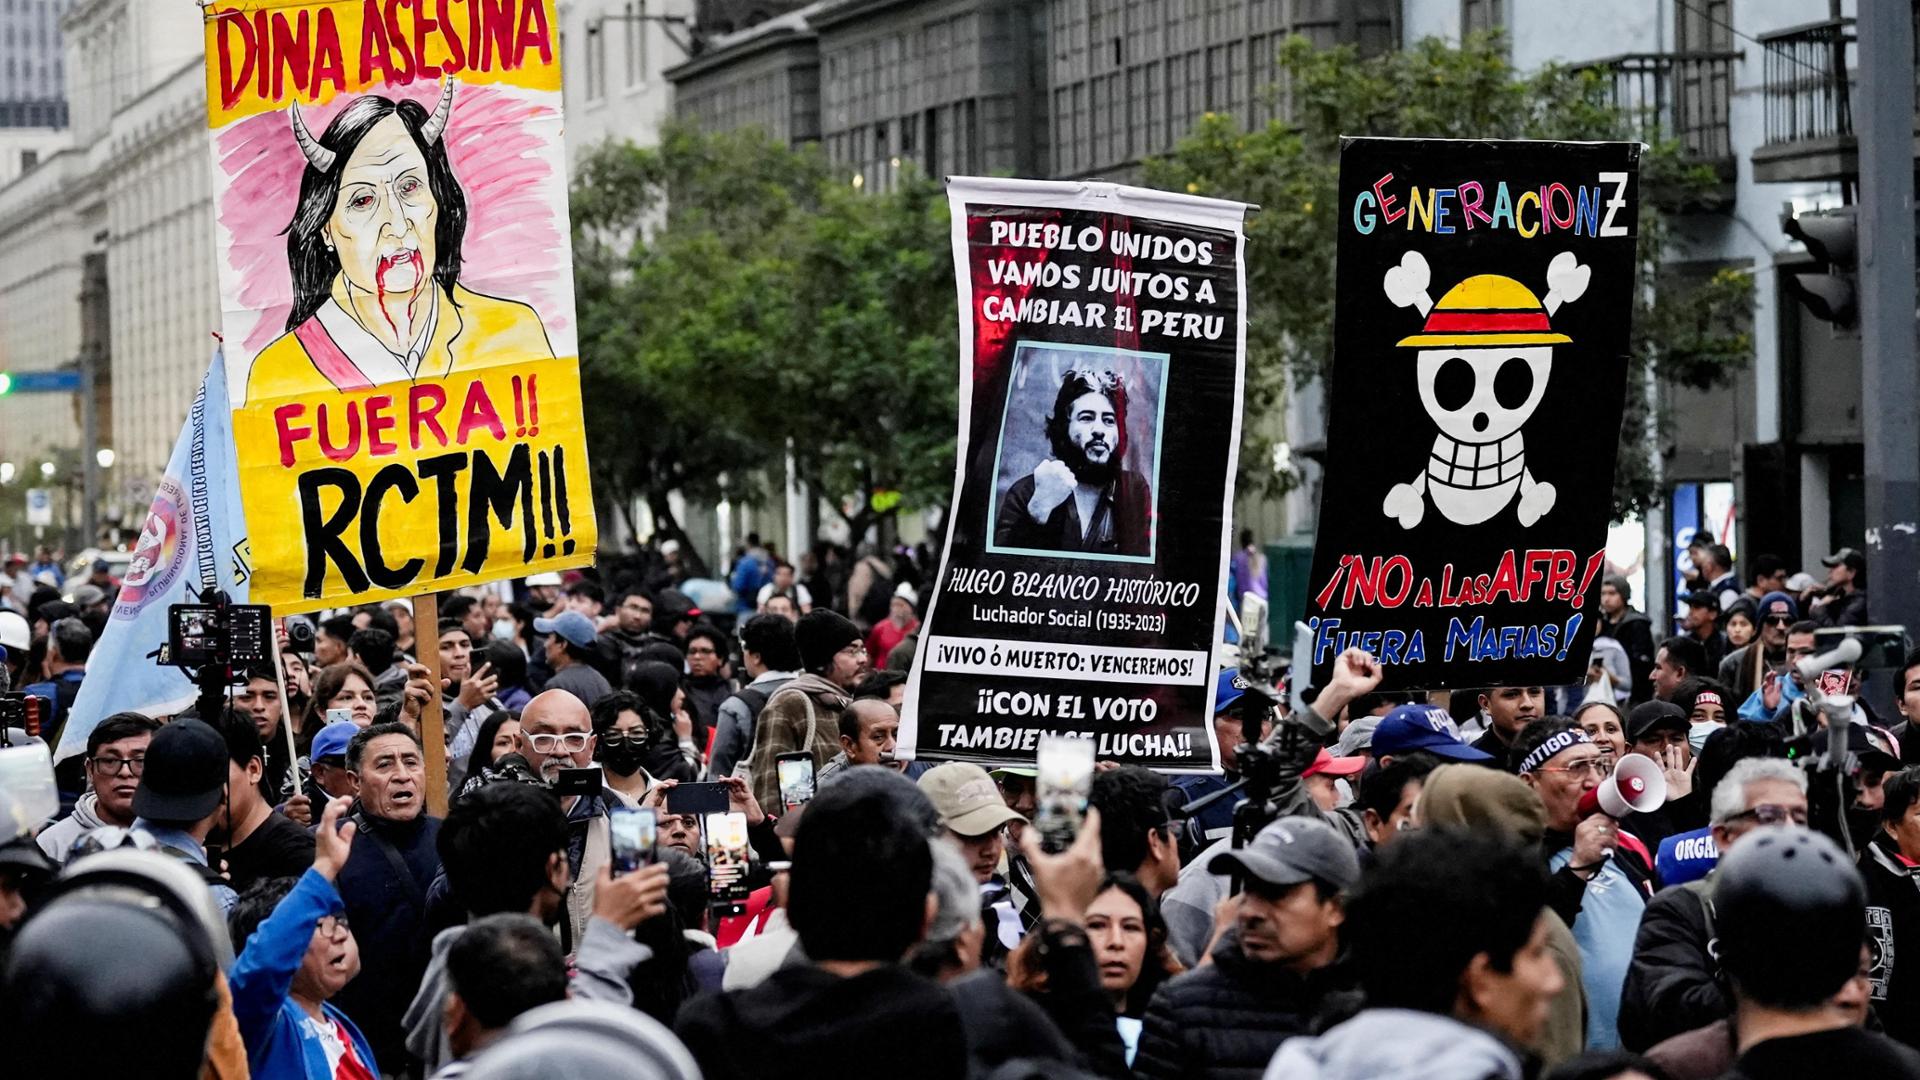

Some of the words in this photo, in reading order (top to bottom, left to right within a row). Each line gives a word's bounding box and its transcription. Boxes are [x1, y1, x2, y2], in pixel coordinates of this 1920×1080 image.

[215, 9, 346, 110] DINA
[359, 0, 554, 86] ASESINA
[1353, 172, 1600, 239] GENERACION
[989, 221, 1104, 252] PUEBLO
[1110, 229, 1214, 266] UNIDOS
[987, 259, 1081, 290] VAMOS
[1088, 266, 1190, 302] JUNTOS
[1195, 278, 1217, 305] A
[982, 295, 1106, 328] CAMBIAR
[1114, 304, 1135, 333] EL
[1140, 311, 1225, 341] PERU
[274, 372, 541, 469] FUERA!!
[297, 440, 577, 599] RCTM!!
[947, 567, 1006, 595] HUGO
[1011, 571, 1100, 601] BLANCO
[1104, 573, 1200, 608] HISTÓRICO
[1315, 554, 1413, 611] ¡NO
[972, 604, 1045, 626] Luchador
[1048, 609, 1092, 629] Social
[1096, 611, 1166, 635] (1935-2023)
[937, 644, 986, 666] ¡VIVO
[1005, 651, 1085, 673] MUERTO:
[1090, 654, 1194, 677] VENCEREMOS!
[977, 688, 1050, 717] ¡¡CON
[1057, 692, 1085, 719] EL
[1093, 697, 1157, 722] VOTO
[1098, 733, 1192, 757] LUCHA!!
